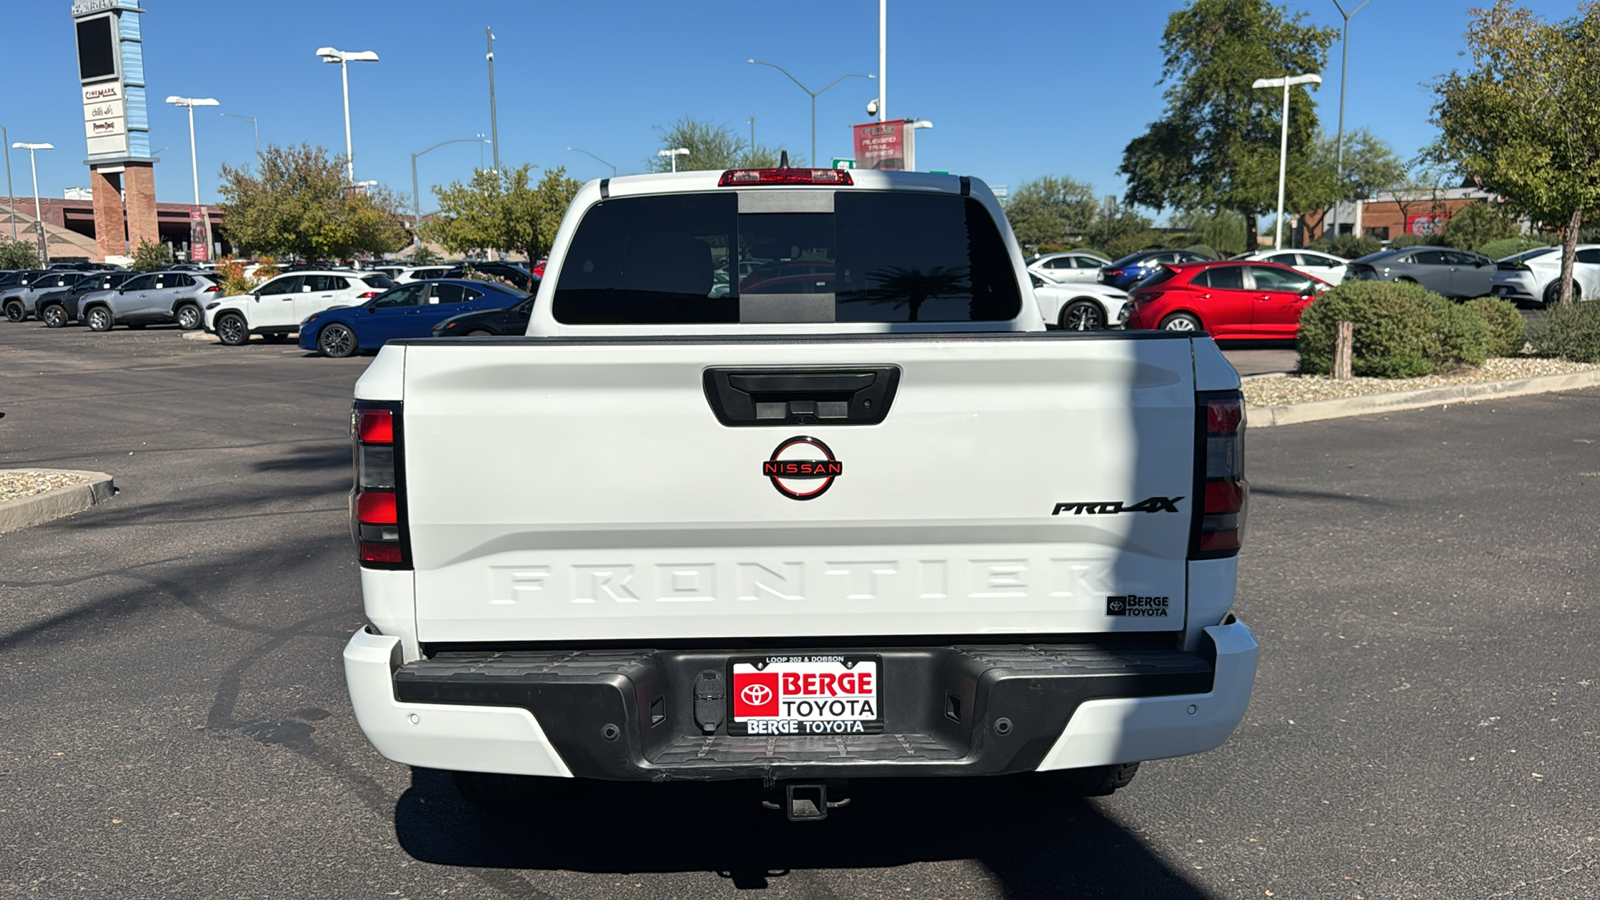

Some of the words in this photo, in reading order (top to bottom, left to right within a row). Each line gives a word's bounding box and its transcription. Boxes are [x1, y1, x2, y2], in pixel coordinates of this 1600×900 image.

[85, 87, 117, 99] CINEMARK
[765, 463, 840, 473] NISSAN
[489, 556, 1115, 604] FRONTIER
[1127, 608, 1168, 617] TOYOTA
[782, 672, 873, 697] BERGE
[782, 700, 874, 717] TOYOTA
[747, 719, 799, 735] BERGE
[803, 720, 864, 733] TOYOTA
